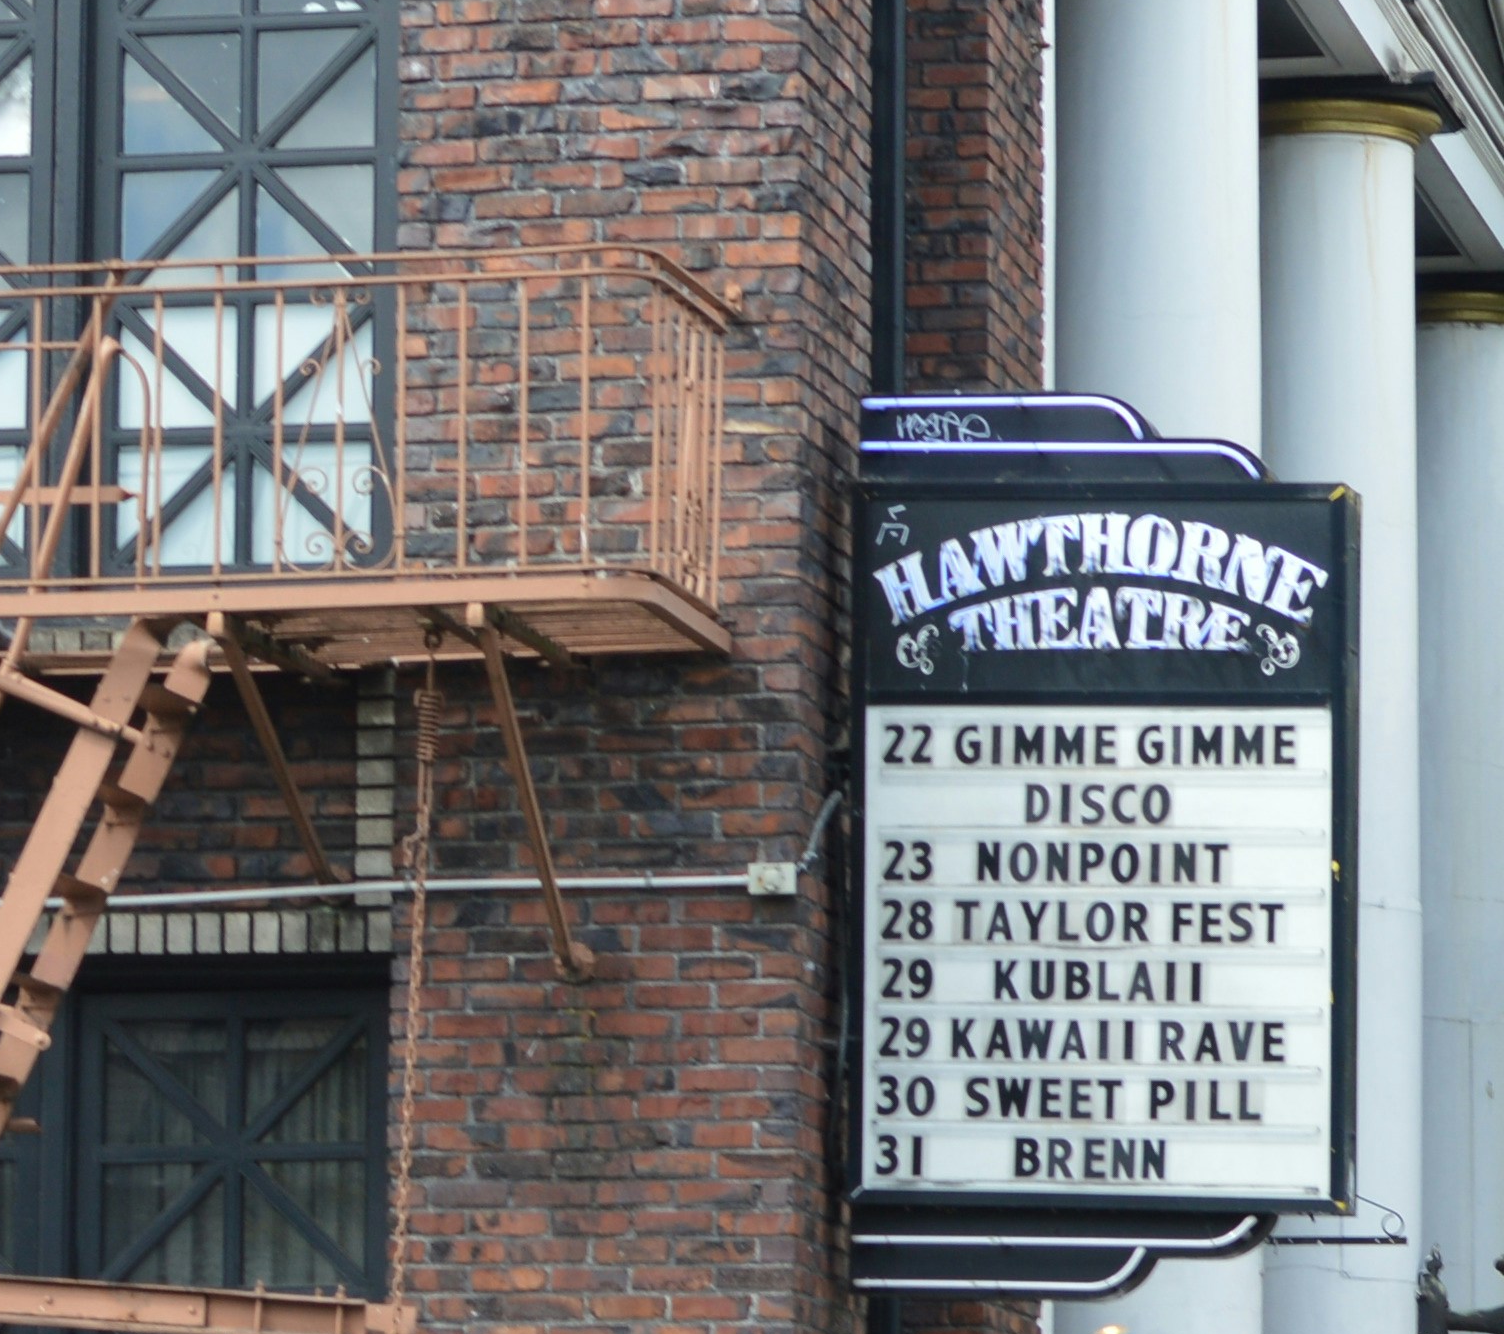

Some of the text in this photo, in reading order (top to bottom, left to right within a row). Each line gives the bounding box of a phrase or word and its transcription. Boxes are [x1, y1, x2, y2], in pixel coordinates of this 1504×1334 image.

[874, 512, 1328, 626] HAWTHORNE
[949, 587, 1250, 650] THEATRE
[883, 724, 1295, 765] 22 GIMME GIMME
[1026, 784, 1170, 826] DISCO
[883, 841, 1228, 884] 23 NONPOINT
[881, 900, 1283, 943] 28 TAYLOR FEST
[882, 958, 1201, 1002] 29 KUBLAII
[879, 1017, 1284, 1062] 29 KAWAII RAVE
[877, 1075, 1260, 1120] 30 SWEET PILL
[876, 1135, 1165, 1179] 31 BRENN
